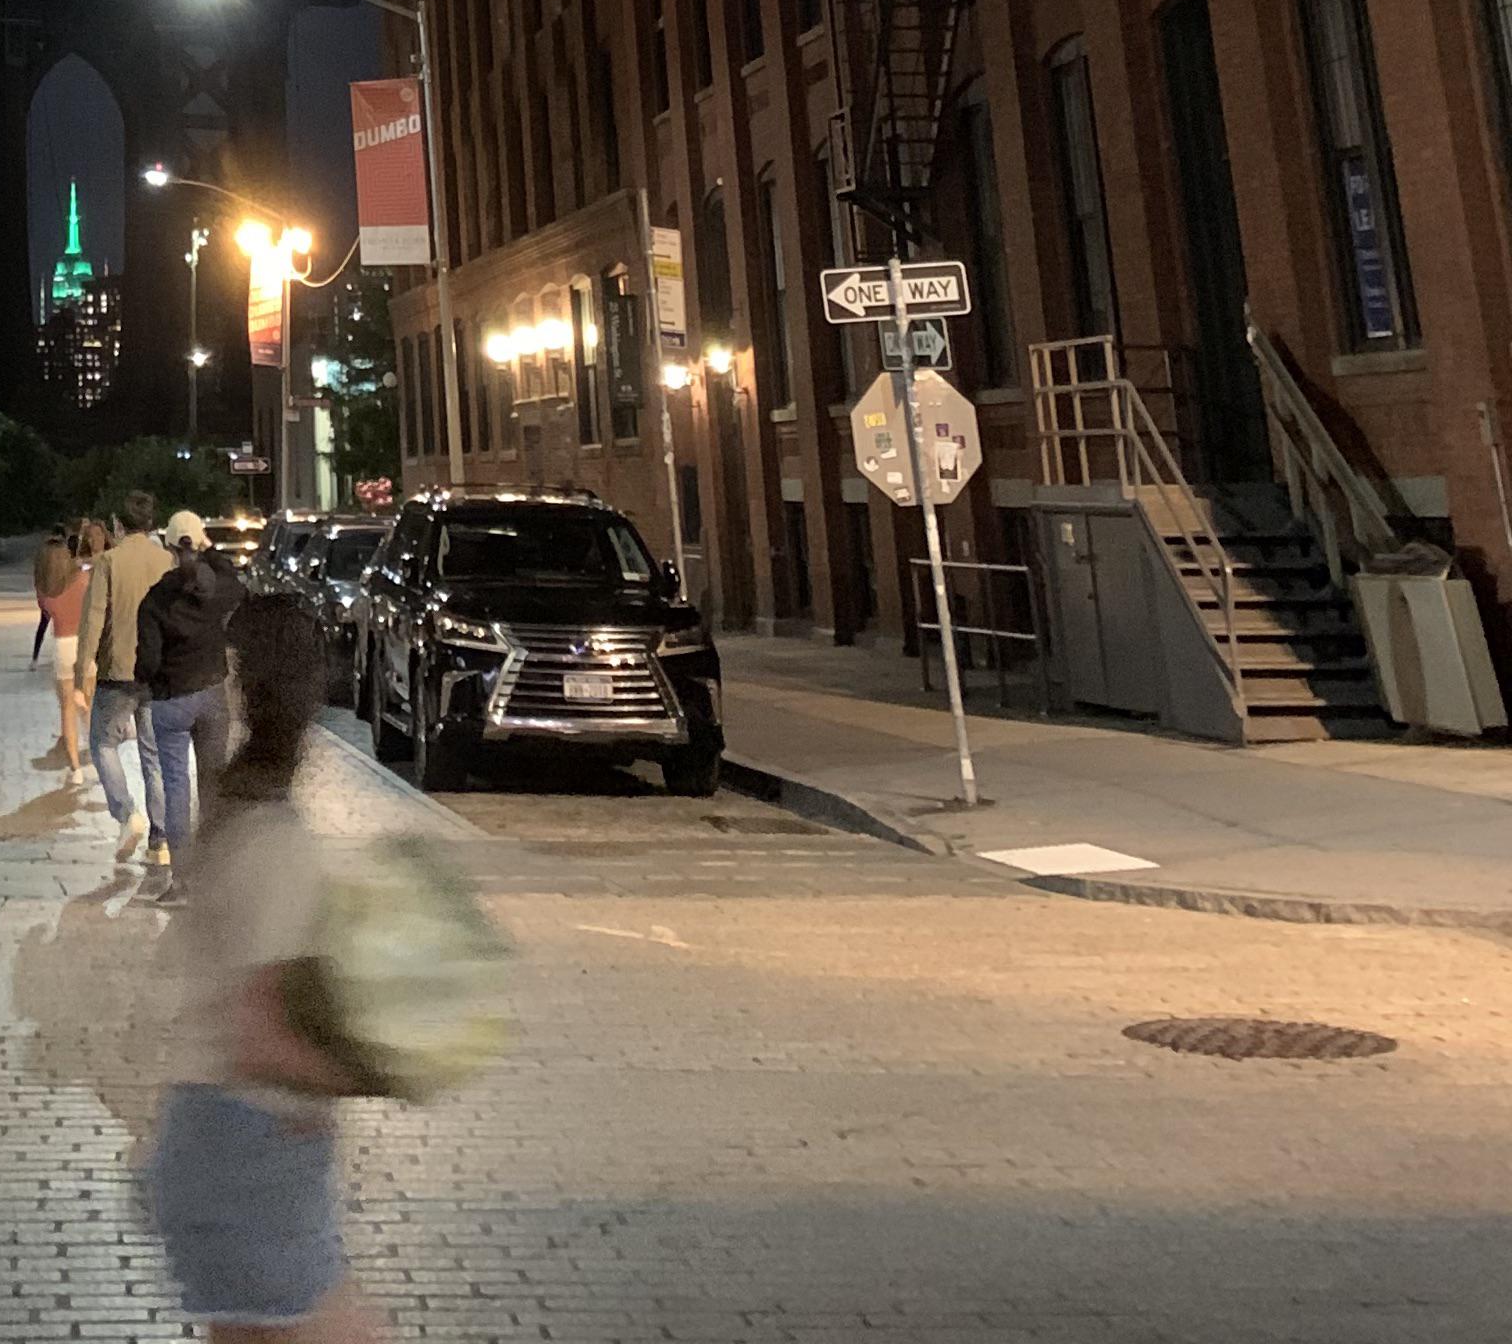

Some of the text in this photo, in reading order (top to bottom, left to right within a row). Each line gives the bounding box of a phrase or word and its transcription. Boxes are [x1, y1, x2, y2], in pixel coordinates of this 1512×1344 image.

[353, 113, 422, 151] DUMBO
[843, 279, 952, 305] ONE WAY
